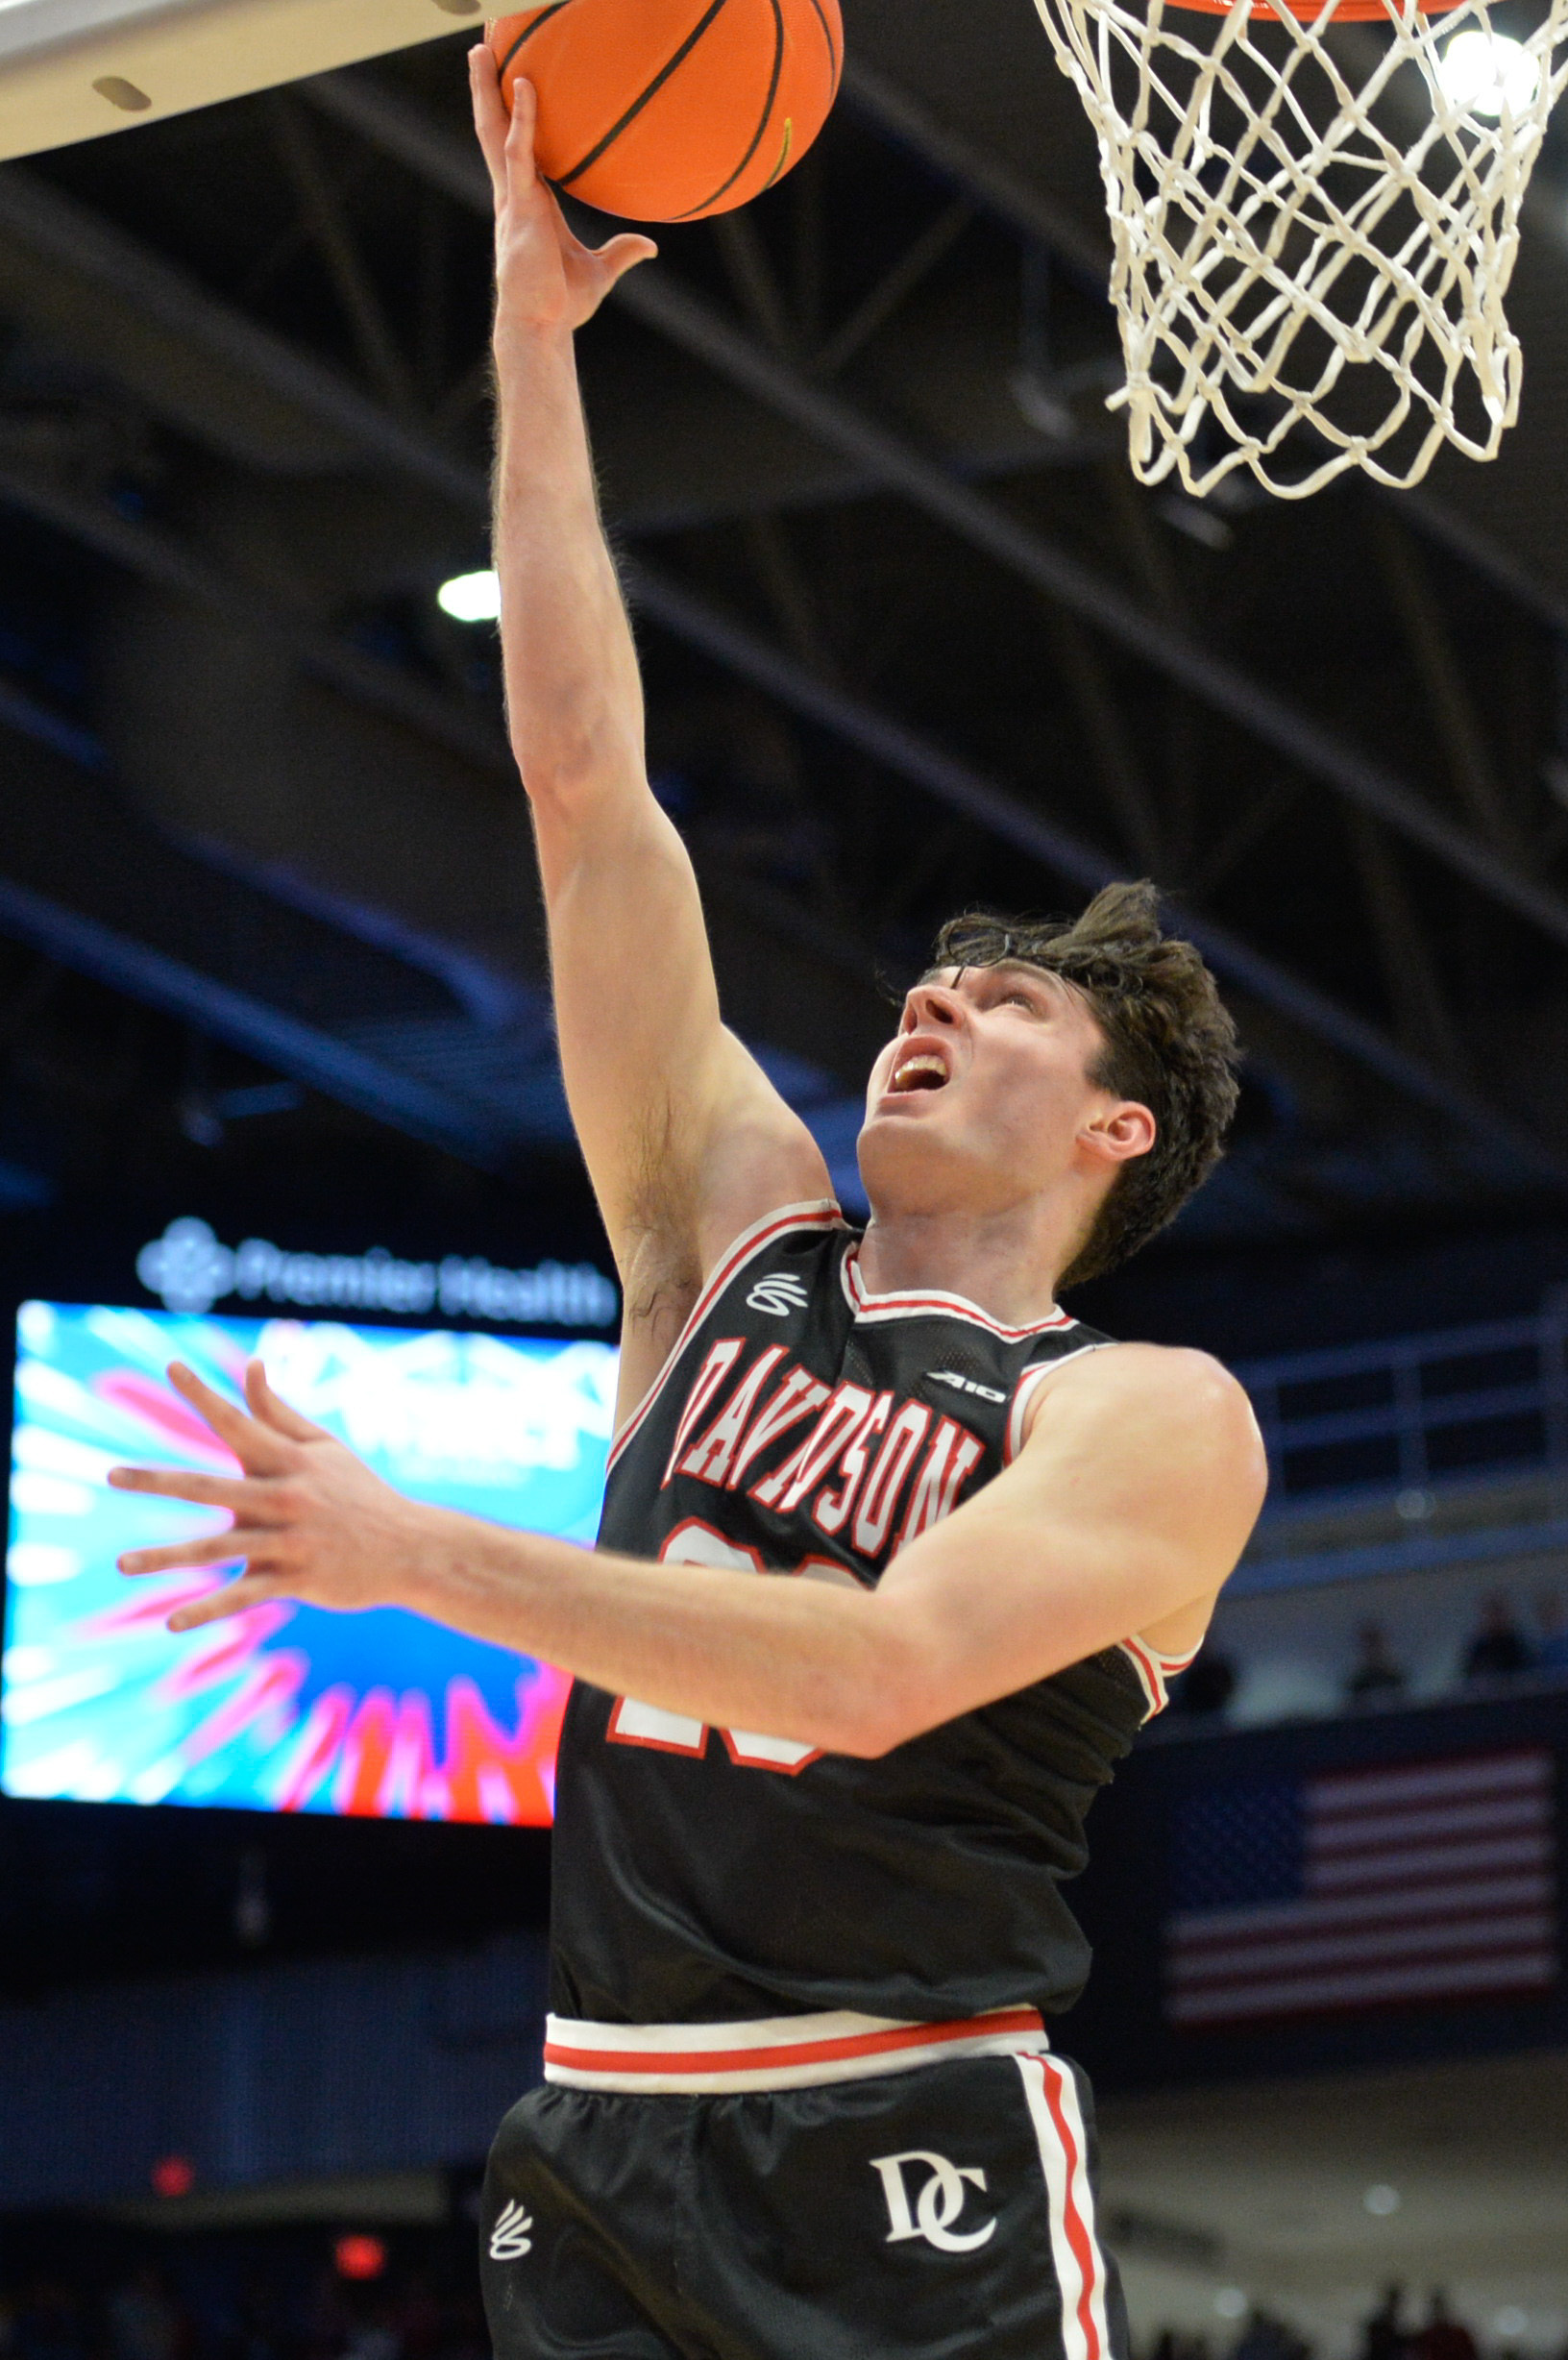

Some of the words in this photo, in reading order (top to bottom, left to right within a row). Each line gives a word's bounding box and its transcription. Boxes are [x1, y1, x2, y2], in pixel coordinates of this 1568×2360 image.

[235, 1238, 436, 1314] Premier
[438, 1254, 618, 1327] Health
[870, 2151, 997, 2252] DC
